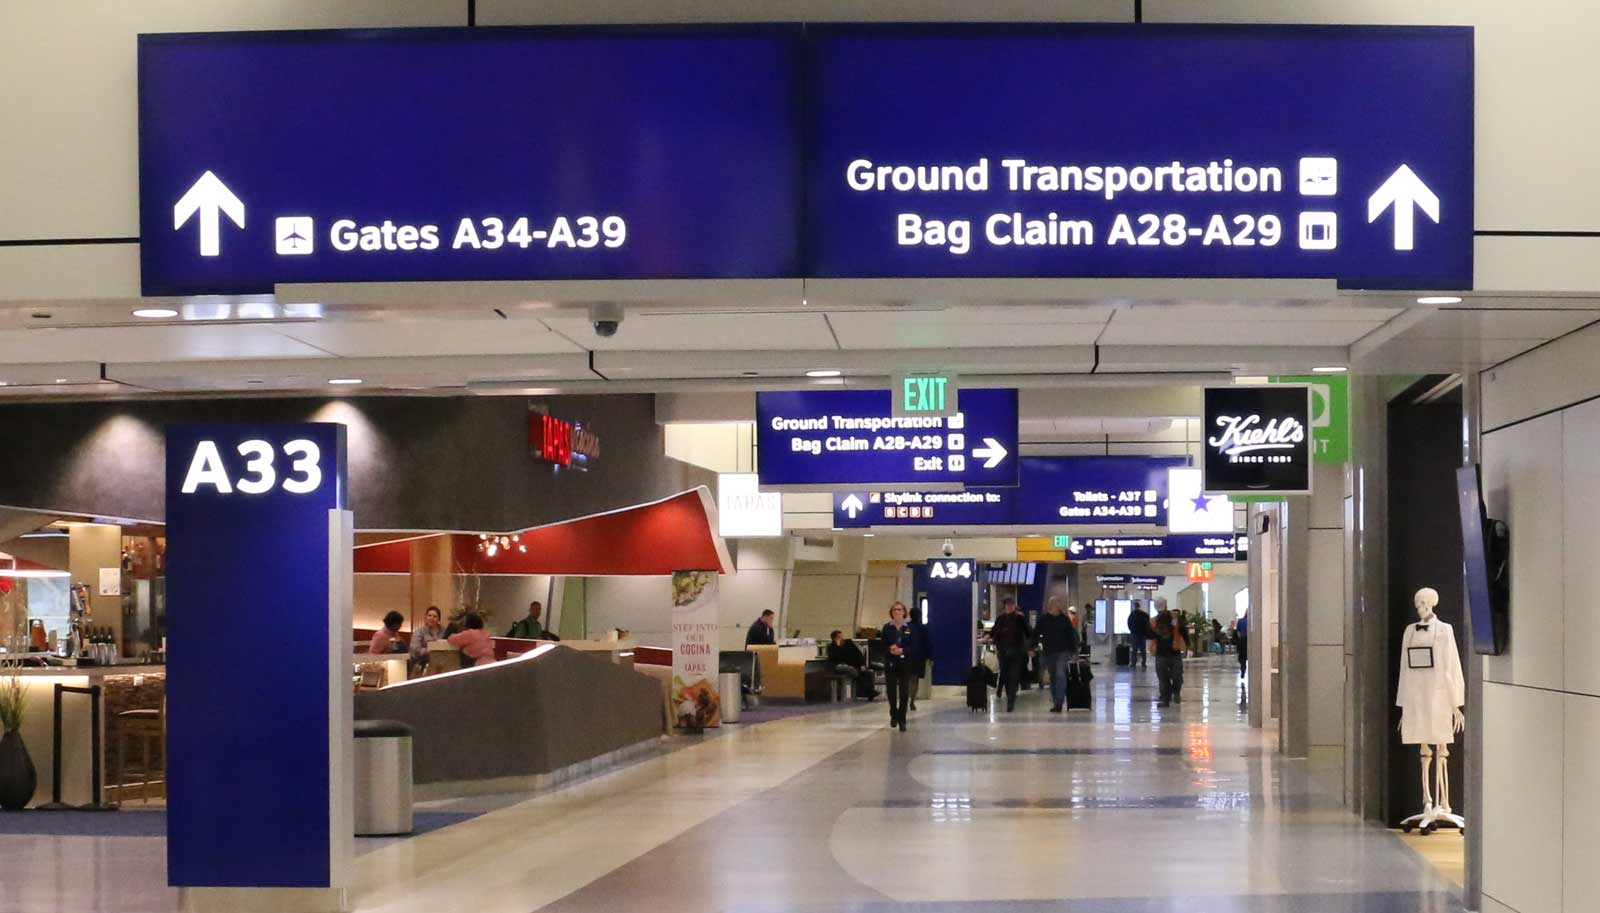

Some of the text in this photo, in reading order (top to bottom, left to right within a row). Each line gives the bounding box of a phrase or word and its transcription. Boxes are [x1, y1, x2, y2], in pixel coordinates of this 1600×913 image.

[846, 157, 1282, 201] Ground Transportation
[330, 215, 627, 252] Gates A34-A39
[897, 212, 1282, 255] Bag Claim A28-A29
[904, 377, 947, 411] EXIT
[771, 415, 942, 432] Ground Transportation
[1208, 414, 1304, 447] Kiehl's
[791, 435, 943, 455] Bag Claim A28-A29
[181, 438, 323, 495] A33
[913, 456, 943, 471] Exit
[1232, 455, 1264, 464] SINCE
[883, 492, 923, 506] Skylink
[924, 492, 984, 503] connection
[1072, 490, 1109, 502] Toilets
[1118, 490, 1142, 502] A37
[1059, 506, 1092, 517] Gates
[930, 561, 972, 579] A34
[696, 624, 718, 632] INTO
[680, 643, 711, 656] COCINA
